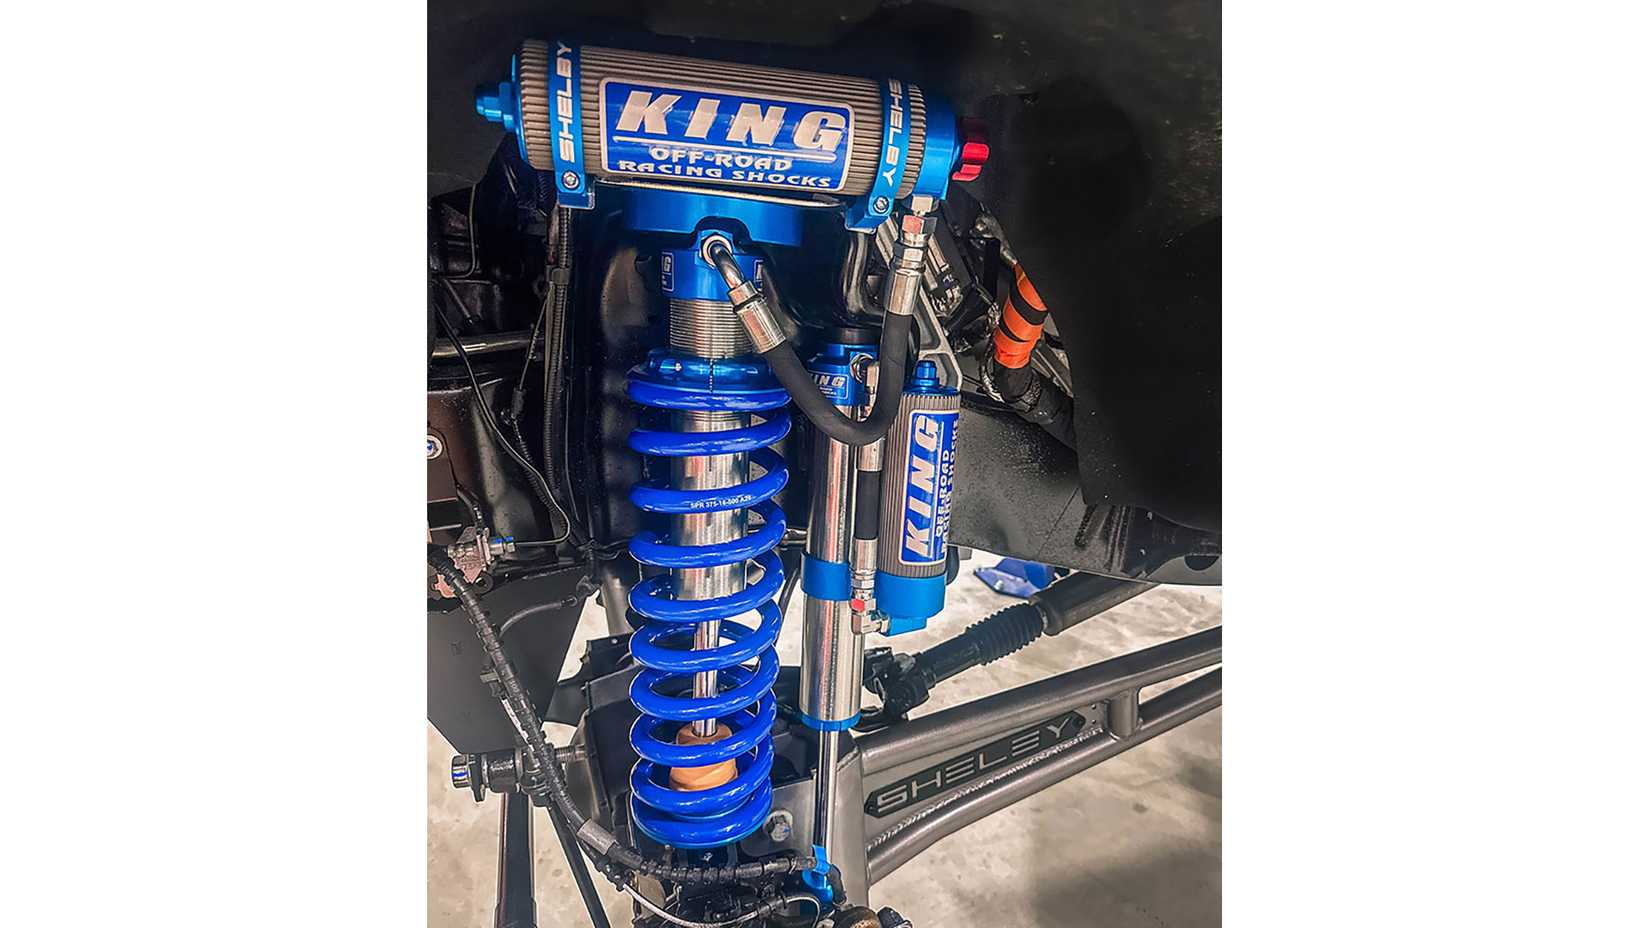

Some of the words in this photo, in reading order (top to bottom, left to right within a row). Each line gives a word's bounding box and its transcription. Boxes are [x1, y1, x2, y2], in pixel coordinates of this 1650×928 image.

[556, 40, 575, 163] SHELBY
[616, 90, 847, 152] KING
[882, 78, 903, 187] SHELBY
[618, 160, 722, 178] RACING
[732, 169, 832, 188] SHOCKS
[650, 147, 792, 171] OFF-ROAD
[810, 373, 846, 387] ING
[905, 415, 938, 558] KING
[936, 450, 950, 538] OFF-ROAD
